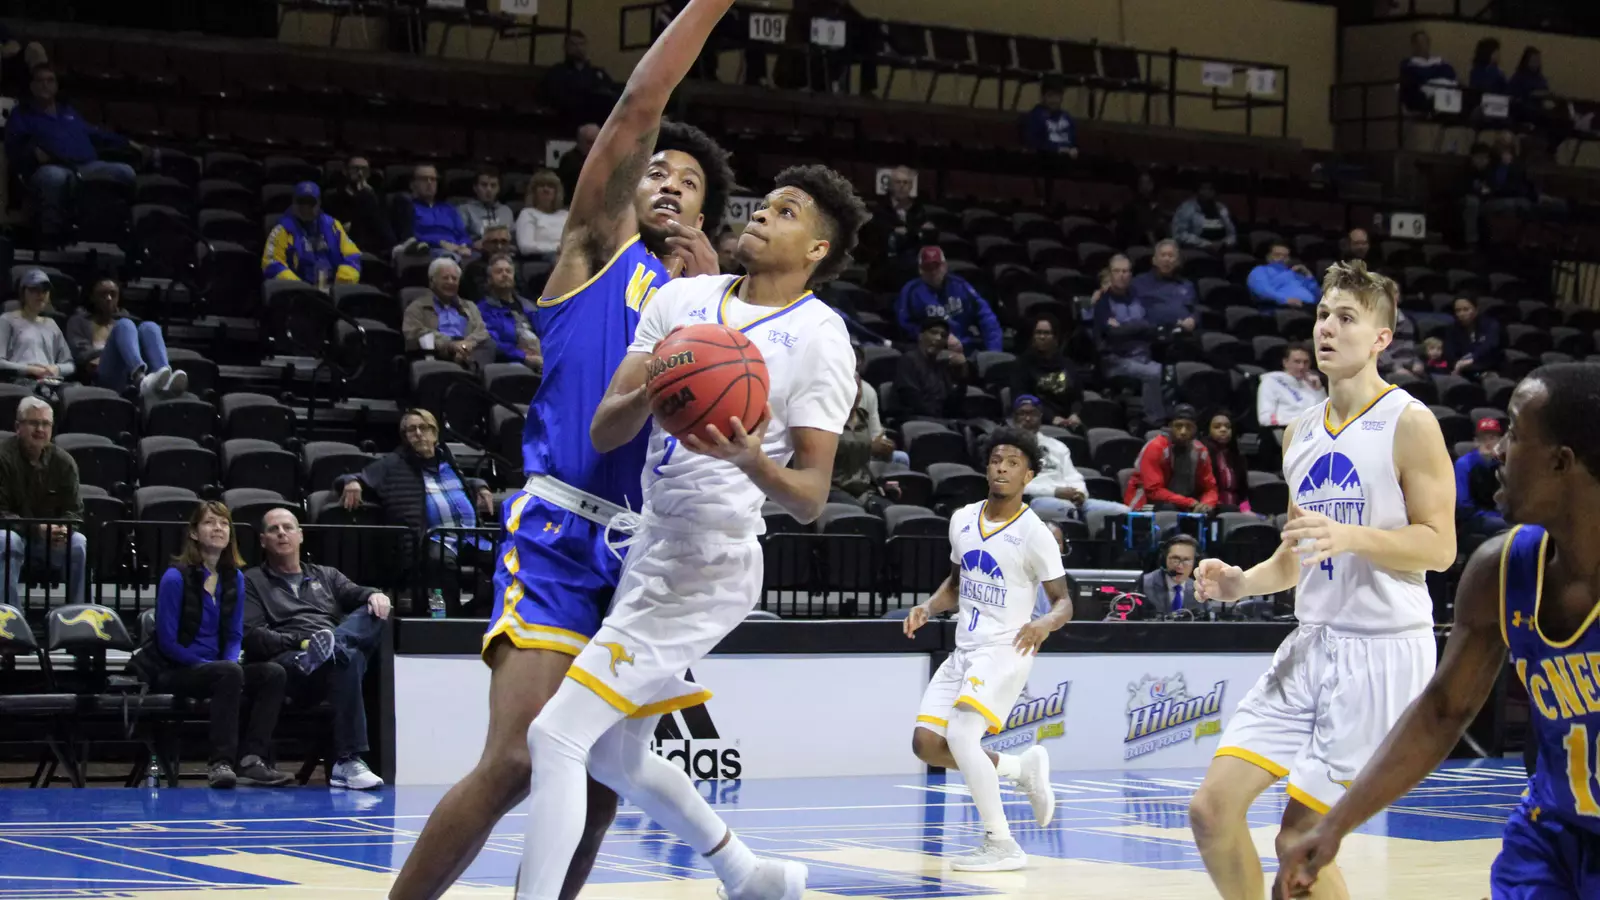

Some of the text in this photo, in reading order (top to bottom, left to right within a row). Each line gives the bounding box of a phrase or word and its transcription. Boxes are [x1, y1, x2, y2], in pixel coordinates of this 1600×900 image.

[752, 17, 783, 38] 109
[1320, 556, 1334, 580] 4
[960, 579, 1008, 606] ANSAS CITY
[968, 606, 980, 632] 0
[1124, 680, 1225, 744] Hiland
[1159, 728, 1192, 748] FOODS
[1563, 723, 1600, 817] 1
